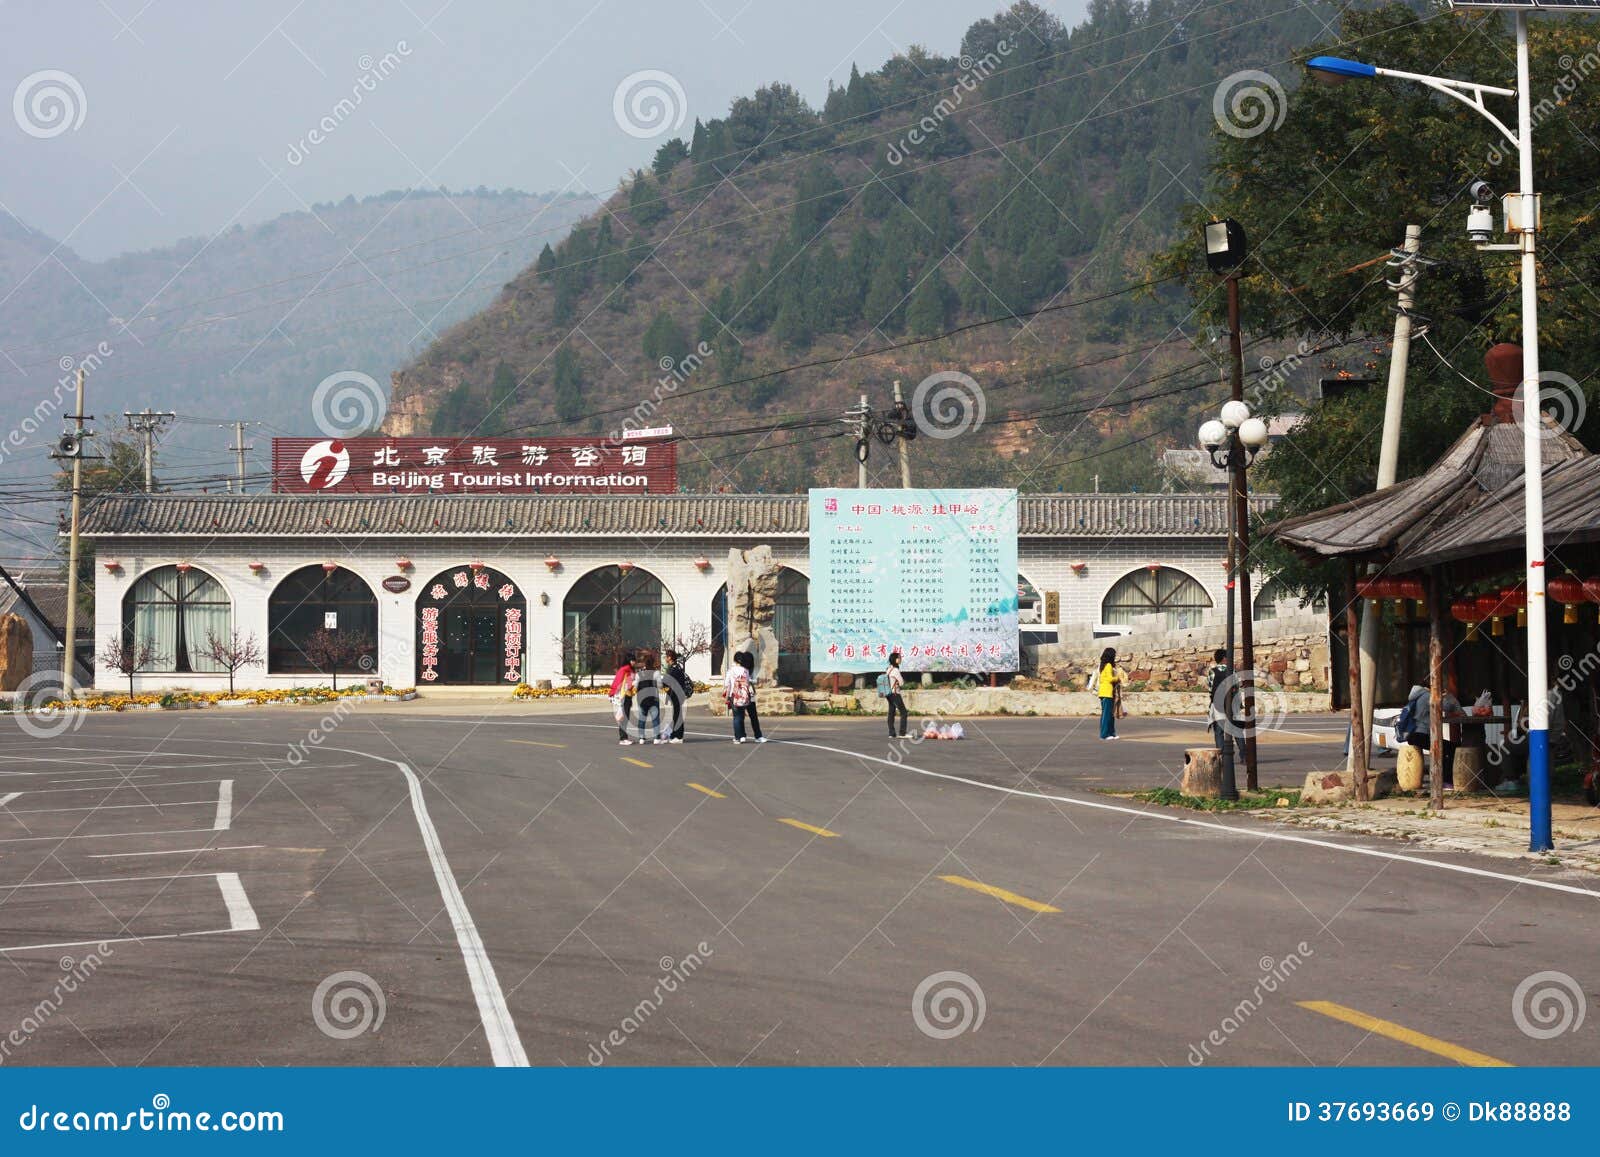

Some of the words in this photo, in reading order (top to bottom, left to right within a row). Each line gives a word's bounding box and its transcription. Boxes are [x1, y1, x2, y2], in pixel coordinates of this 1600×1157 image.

[372, 446, 648, 467] 北京旅游咨询
[372, 472, 445, 489] Beijing
[449, 472, 522, 486] Tourist
[525, 472, 648, 487] Information
[421, 607, 439, 682] 游客服务中心
[504, 607, 522, 682] 咨询预订中心
